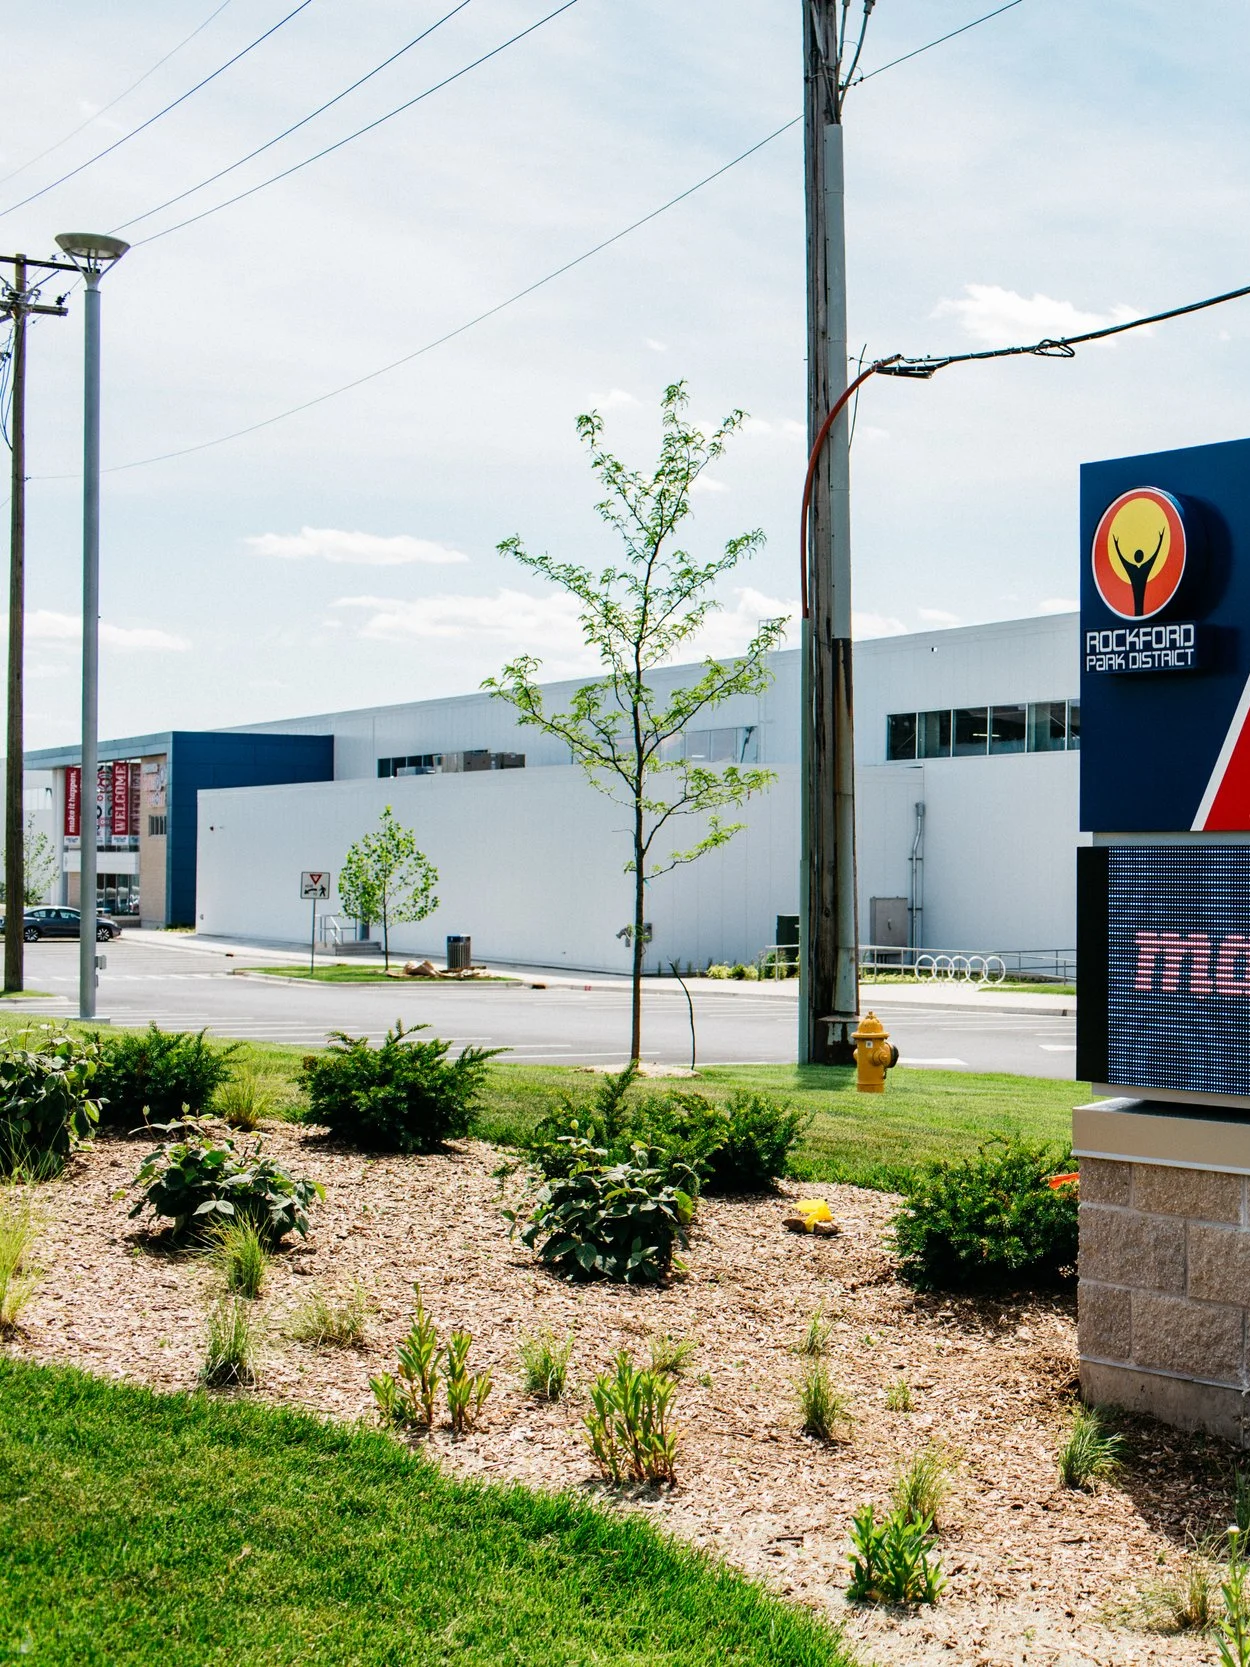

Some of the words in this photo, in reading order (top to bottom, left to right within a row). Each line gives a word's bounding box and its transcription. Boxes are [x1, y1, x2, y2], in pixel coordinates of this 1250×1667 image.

[1086, 624, 1195, 654] ROCKFORD
[1129, 648, 1195, 669] DISTRICT
[115, 765, 126, 832] WELCOME
